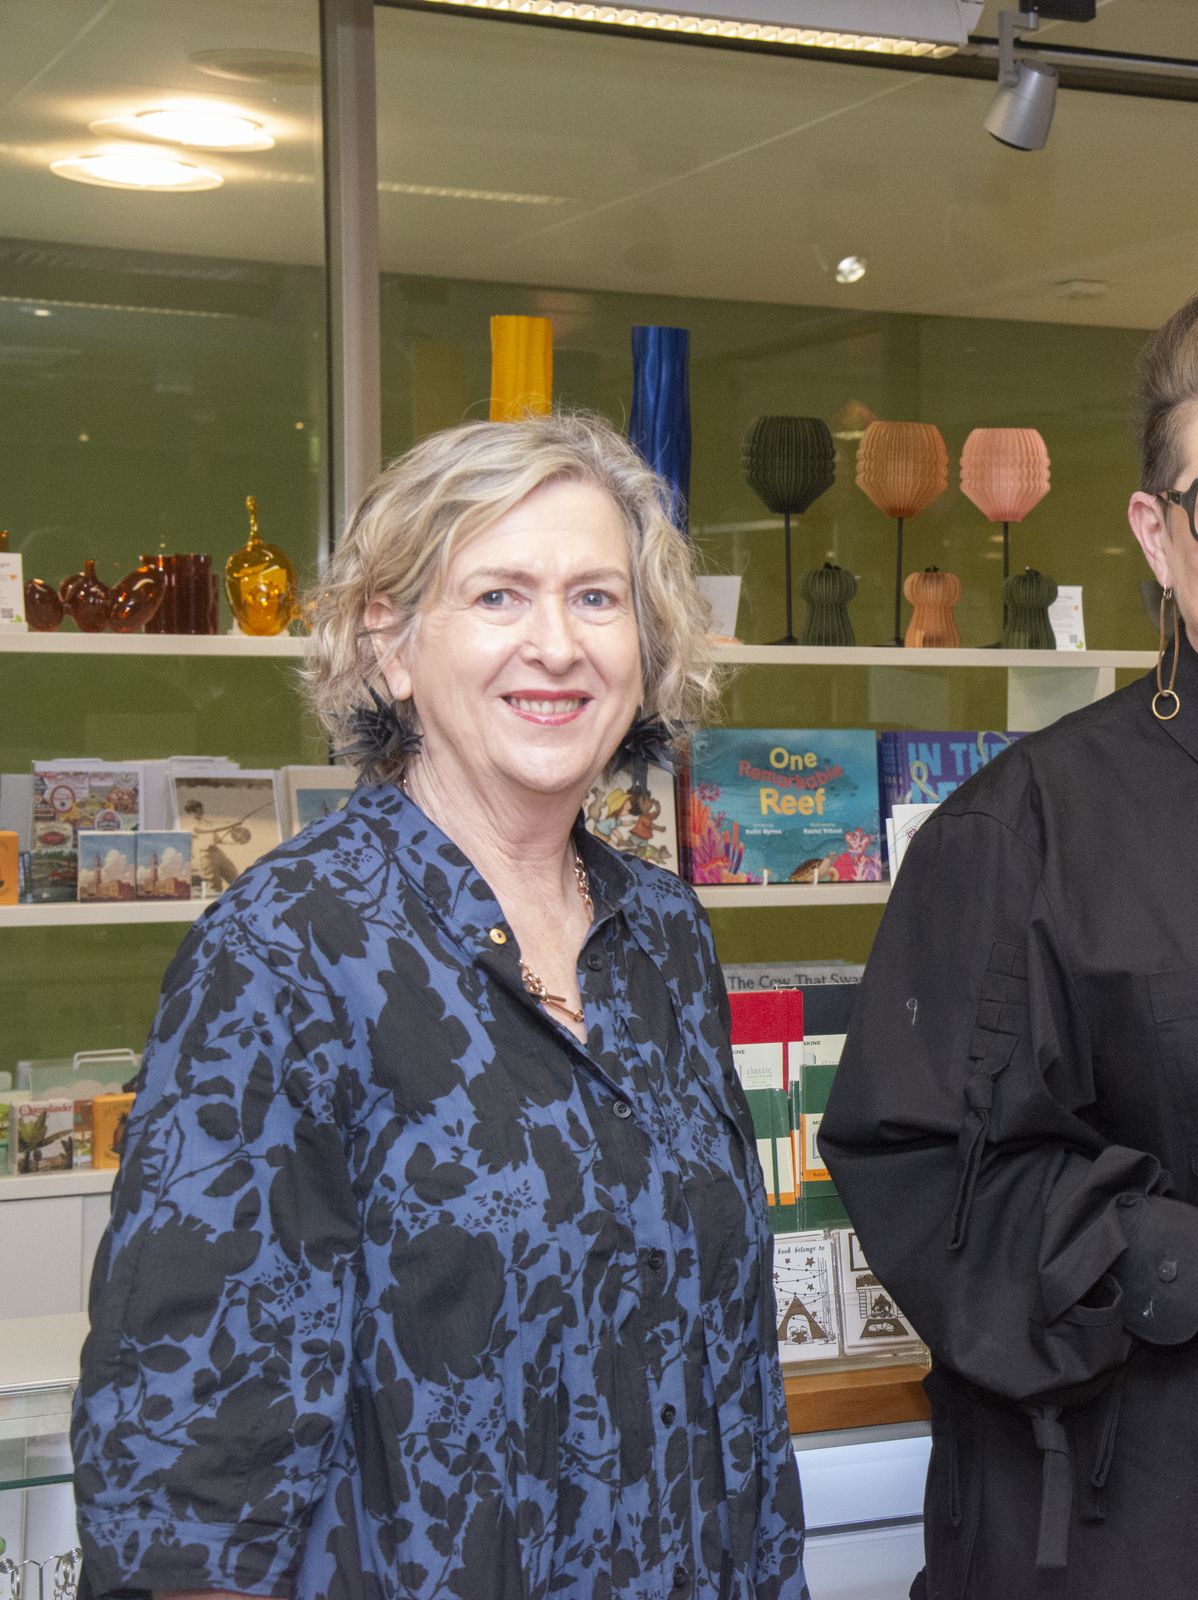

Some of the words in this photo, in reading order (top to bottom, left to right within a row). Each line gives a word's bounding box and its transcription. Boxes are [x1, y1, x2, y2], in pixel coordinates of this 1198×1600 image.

[769, 747, 818, 770] One
[907, 742, 942, 776] IN
[738, 759, 843, 790] Remarkable
[759, 787, 826, 816] Reef
[727, 975, 754, 990] The
[758, 974, 791, 989] Cow
[794, 973, 826, 986] That
